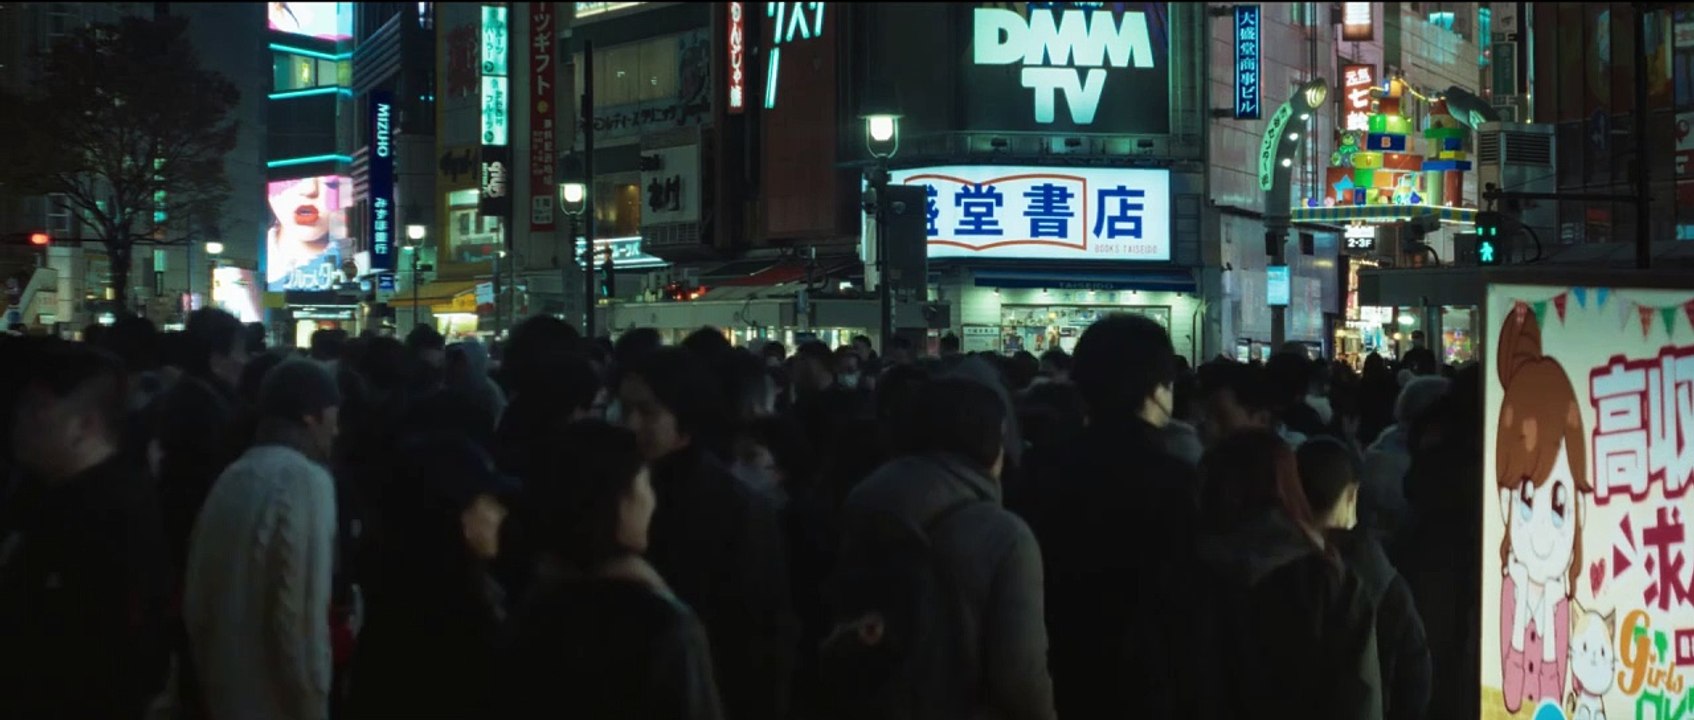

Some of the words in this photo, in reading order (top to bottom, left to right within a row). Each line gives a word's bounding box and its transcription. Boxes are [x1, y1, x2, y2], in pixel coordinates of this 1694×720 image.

[974, 8, 1153, 68] DMM
[1240, 11, 1256, 113] 大盛堂商事ビル
[1022, 67, 1107, 124] TV
[378, 103, 390, 158] MIZUHO
[927, 184, 1145, 238] 堂書店
